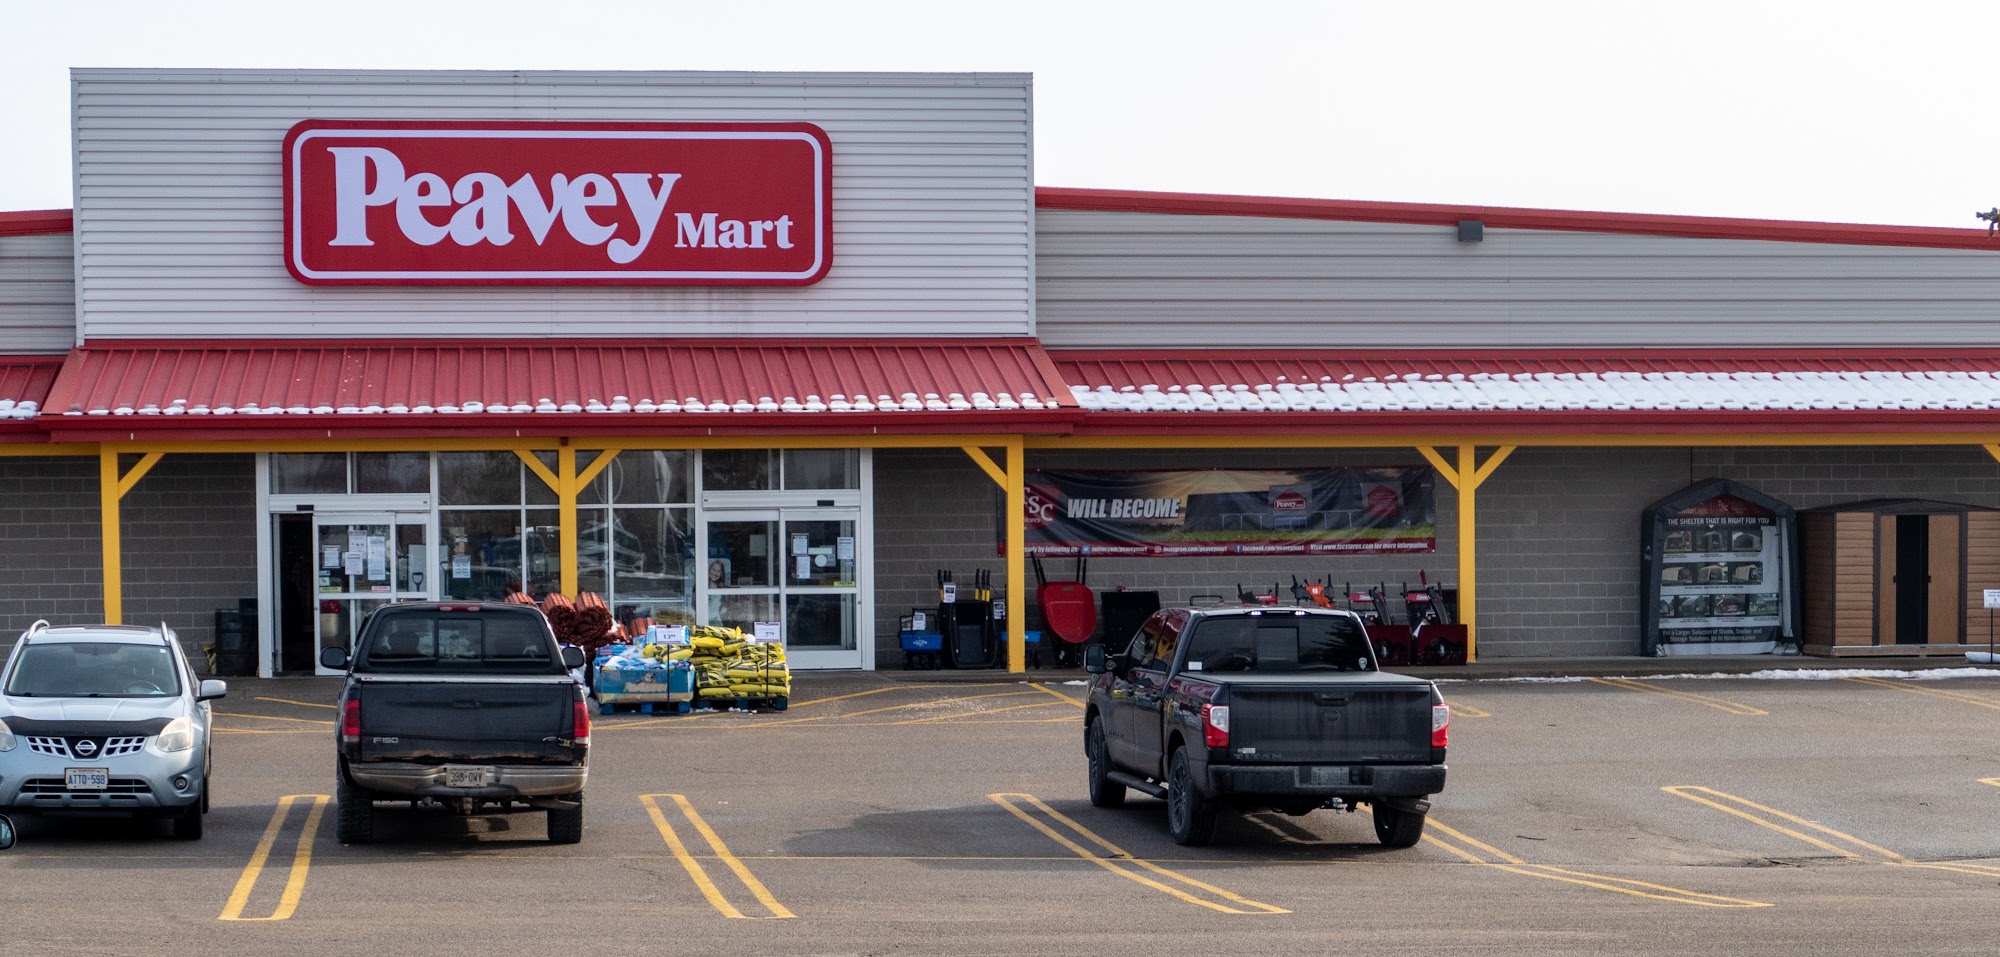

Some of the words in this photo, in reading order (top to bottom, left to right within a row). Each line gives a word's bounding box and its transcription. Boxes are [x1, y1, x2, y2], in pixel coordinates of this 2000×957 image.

[327, 146, 682, 264] Peavey
[674, 213, 794, 249] Mart
[1067, 498, 1107, 518] WILL
[1110, 498, 1181, 519] BECOME
[1668, 518, 1679, 526] THE
[1705, 517, 1720, 525] THAT
[1720, 517, 1727, 525] IS
[1727, 517, 1745, 525] RIGHT
[1745, 517, 1757, 525] FOR
[1757, 516, 1770, 525] YOU
[1675, 629, 1691, 637] Larger
